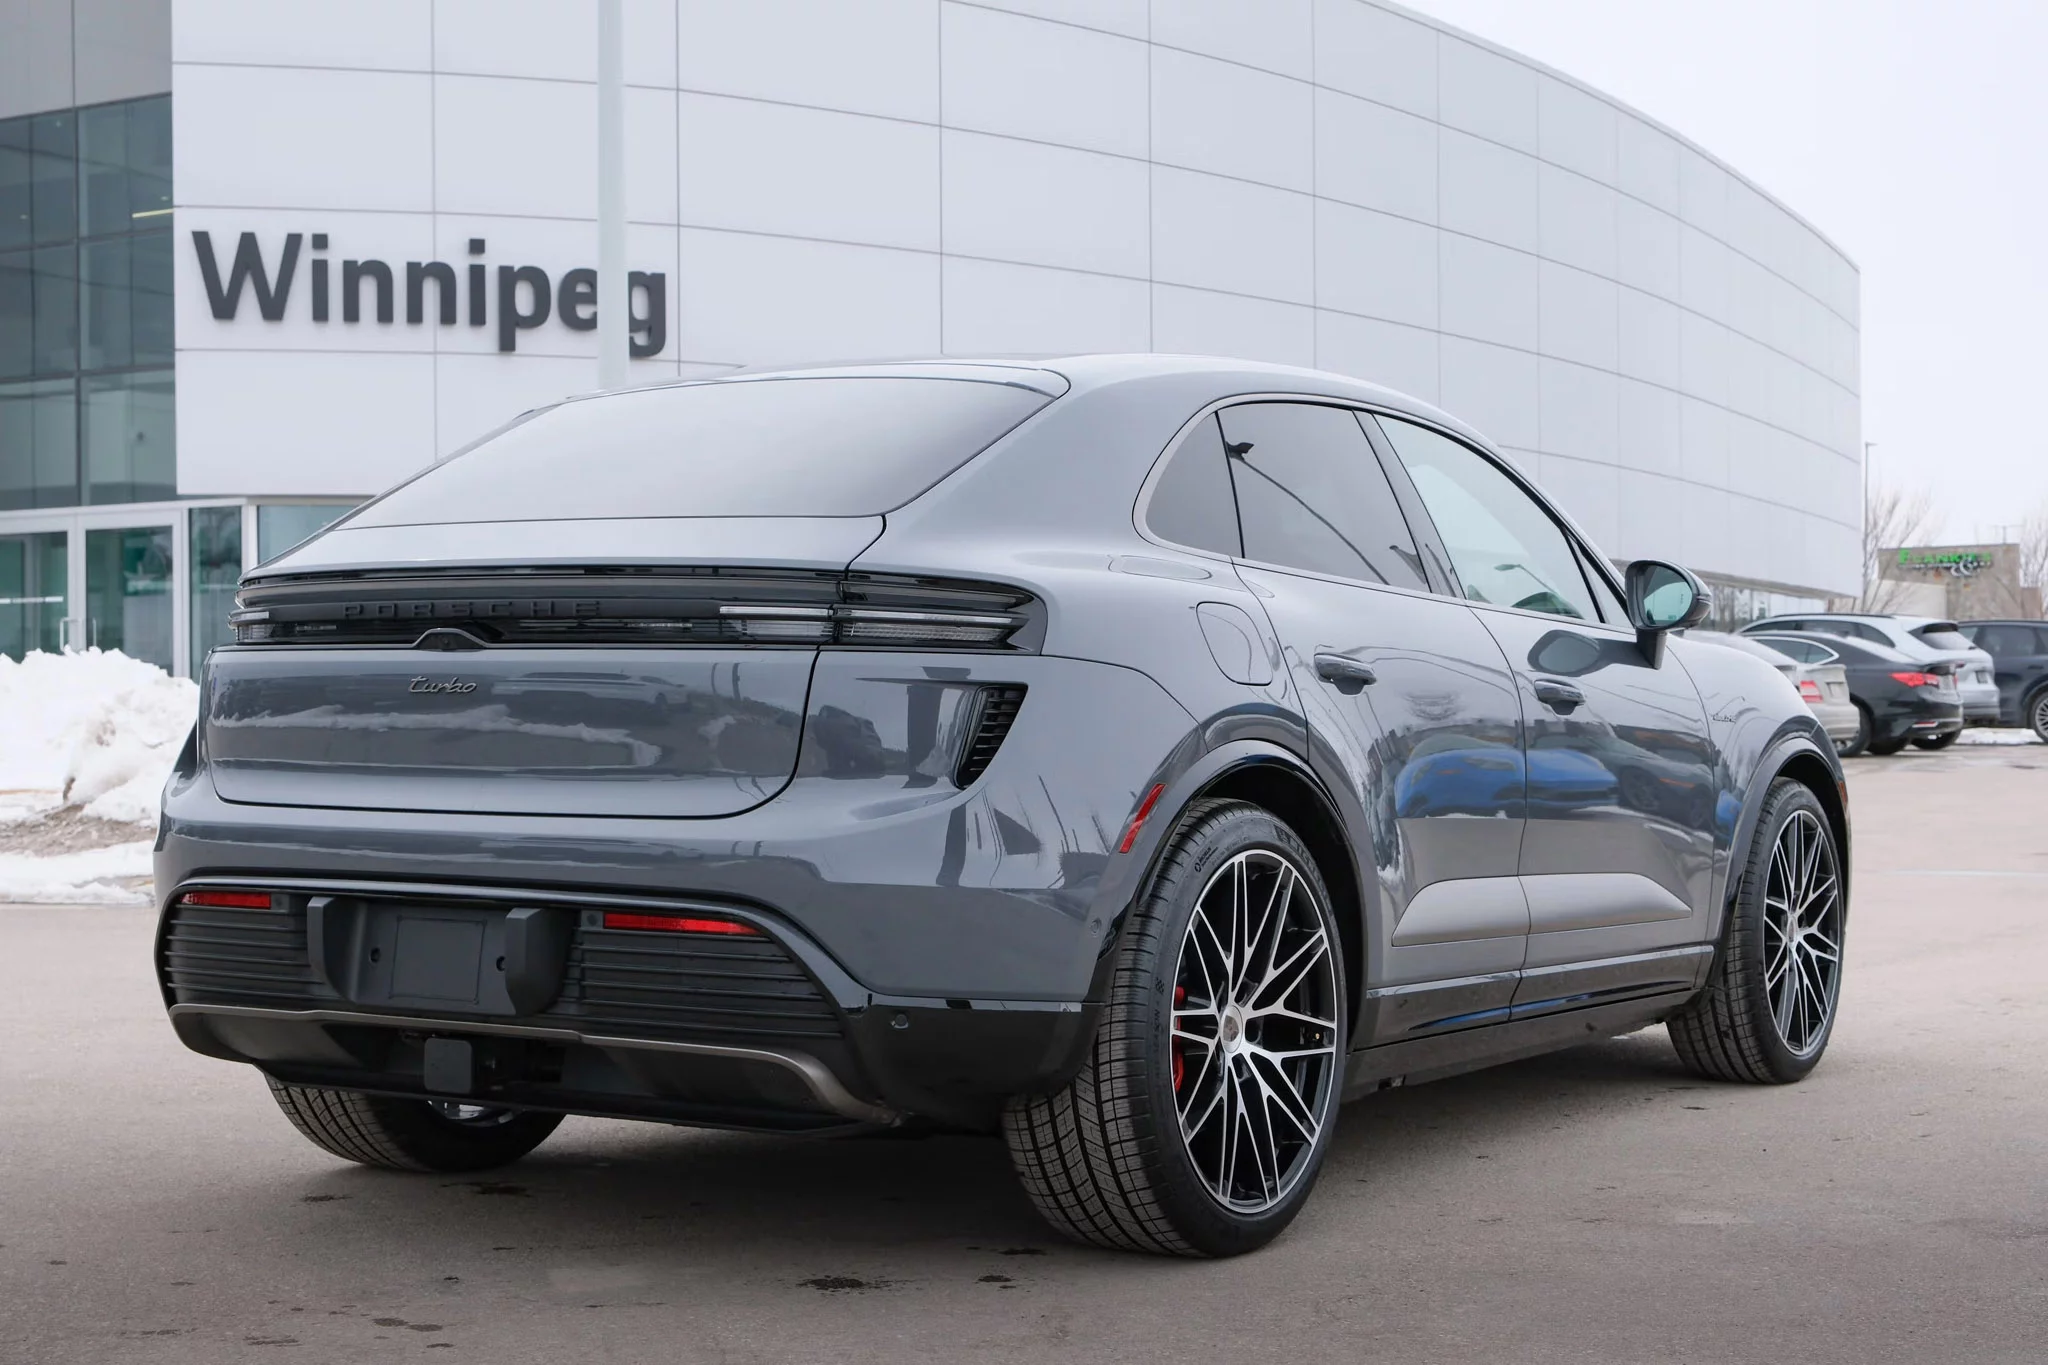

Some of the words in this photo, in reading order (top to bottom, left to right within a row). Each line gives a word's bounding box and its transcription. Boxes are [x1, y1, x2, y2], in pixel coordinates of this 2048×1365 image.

[191, 231, 667, 358] Winnipeg
[344, 601, 600, 618] PORSCHE
[408, 675, 478, 694] turbo
